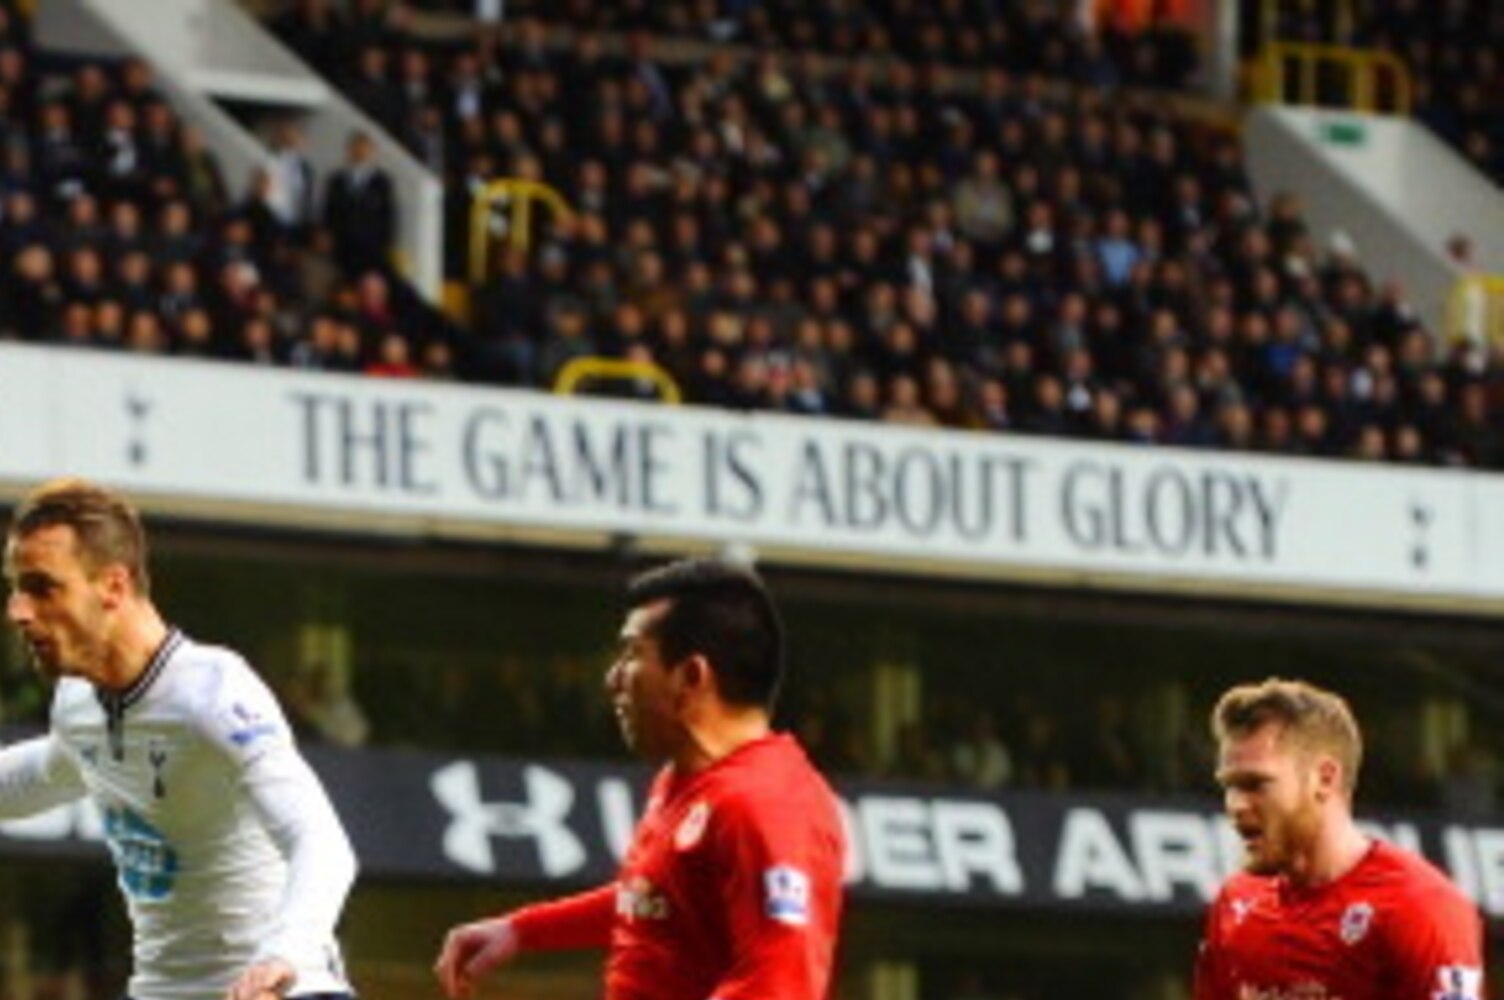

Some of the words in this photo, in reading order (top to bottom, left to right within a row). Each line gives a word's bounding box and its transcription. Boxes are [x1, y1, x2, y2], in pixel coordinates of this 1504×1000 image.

[286, 391, 437, 495] THE
[462, 404, 677, 517] GAME
[701, 432, 764, 523] IS
[788, 438, 1043, 546] ABOUT
[1060, 460, 1293, 563] GLORY
